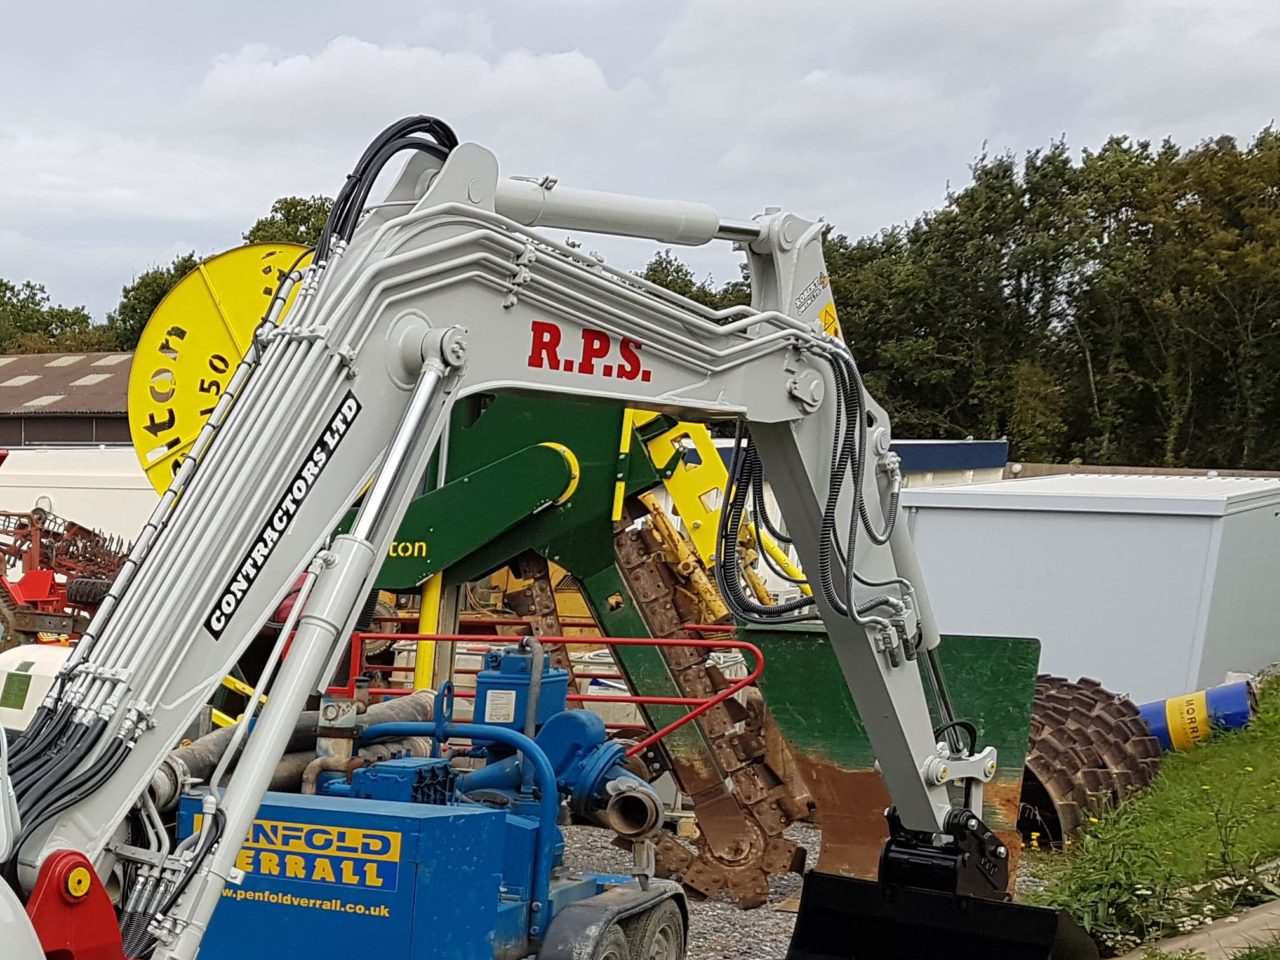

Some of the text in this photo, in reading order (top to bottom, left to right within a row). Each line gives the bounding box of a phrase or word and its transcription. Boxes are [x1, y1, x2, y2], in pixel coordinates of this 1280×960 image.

[527, 320, 652, 382] R.P.S.
[209, 397, 358, 632] CONTRACTORS LTD
[1185, 698, 1201, 742] MORRI
[236, 849, 384, 887] ERRALL
[222, 887, 390, 917] w.penfoldverrall.co.uk
